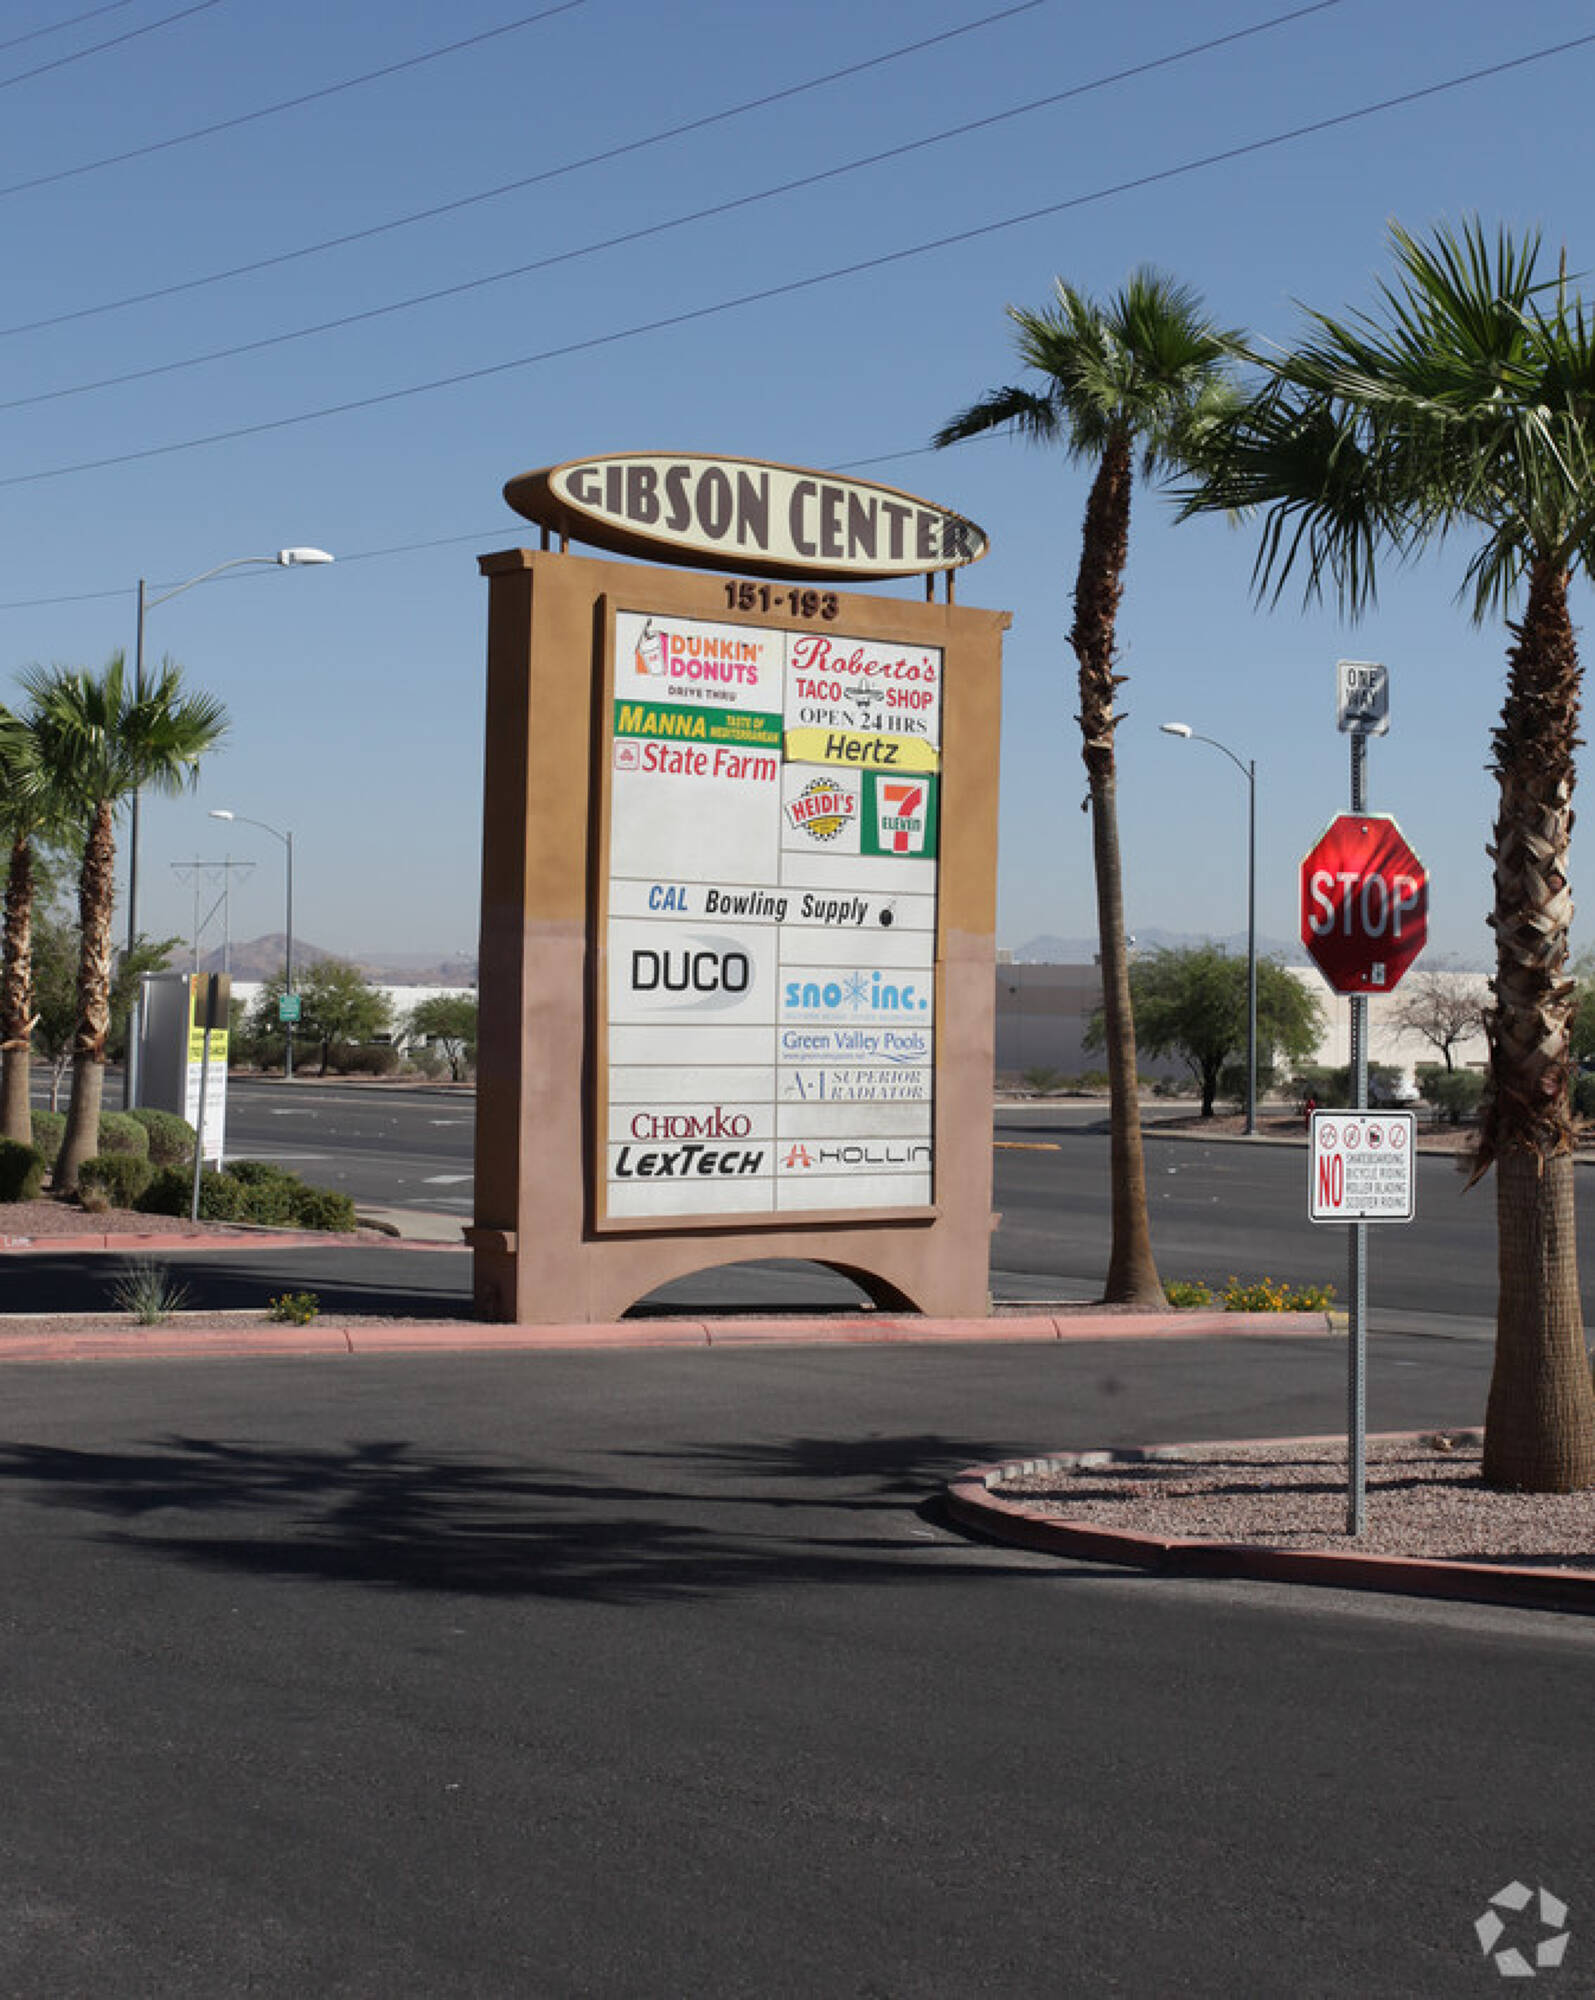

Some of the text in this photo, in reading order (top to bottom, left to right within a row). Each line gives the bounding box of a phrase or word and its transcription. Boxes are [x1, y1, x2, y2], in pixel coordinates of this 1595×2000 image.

[566, 465, 973, 560] GIBSON CENTER
[724, 580, 840, 620] 151-193
[670, 635, 763, 662] DUNKIN'
[791, 637, 937, 683] Roberto's
[670, 659, 759, 685] DONUTS
[1347, 668, 1378, 688] ONE
[668, 684, 737, 702] DRIVE THRU
[796, 678, 934, 710] TACO SHOP
[1345, 688, 1378, 707] WAY
[618, 705, 706, 738] MANNA
[800, 706, 928, 733] OPEN 24 HRS
[642, 743, 776, 782] State Farm
[824, 735, 899, 765] Hertz
[791, 793, 855, 823] HEIDI'S
[883, 783, 922, 854] 7
[649, 885, 869, 925] CAL Bowling Supply
[1308, 870, 1419, 938] STOP
[632, 949, 750, 992] DUCO
[785, 970, 928, 1011] sno inc.
[782, 1030, 926, 1054] Green Valley Pools
[831, 1070, 921, 1084] SUPERIOR
[831, 1086, 924, 1100] RADIATOR
[1319, 1153, 1343, 1208] NO
